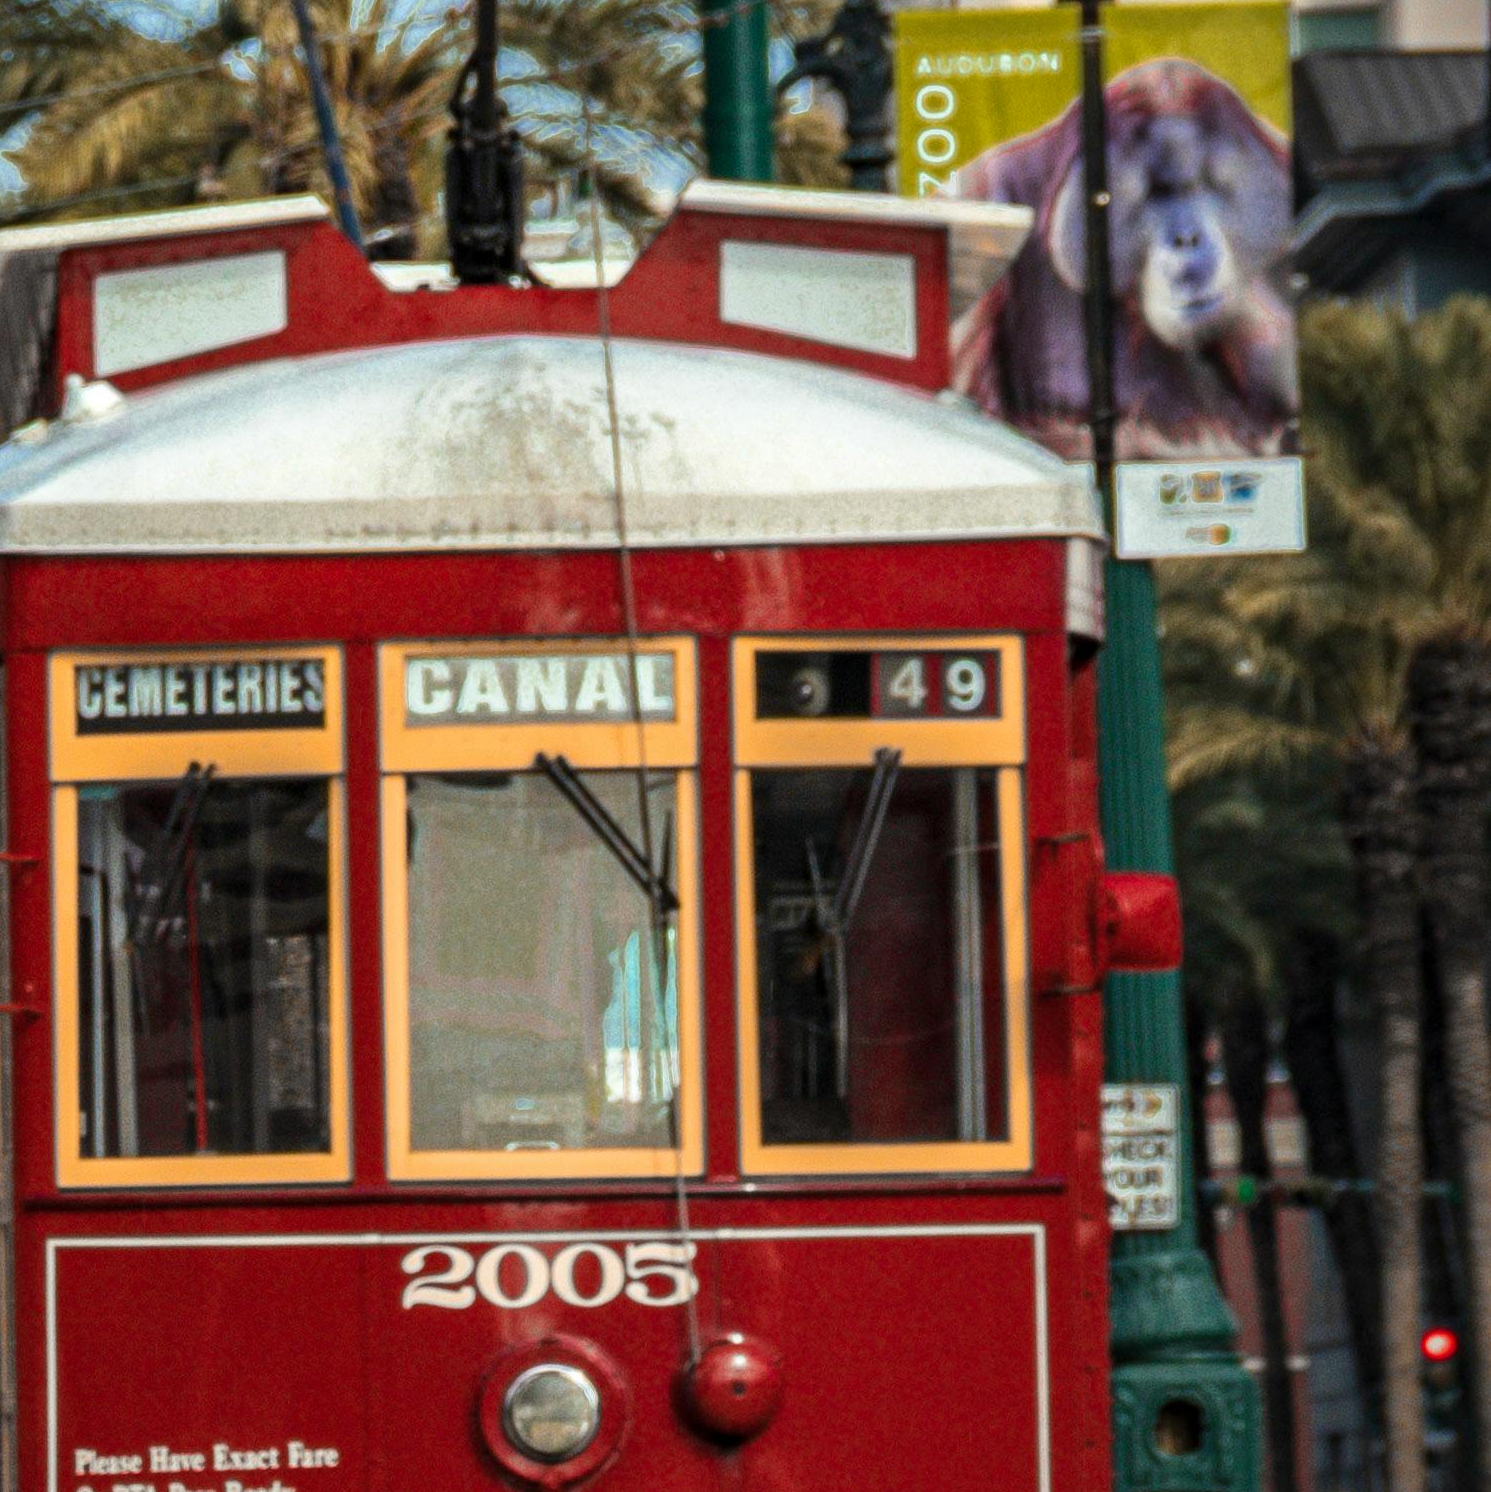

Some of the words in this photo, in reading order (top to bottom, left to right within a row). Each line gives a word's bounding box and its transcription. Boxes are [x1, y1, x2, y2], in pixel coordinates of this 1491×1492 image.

[916, 52, 1061, 76] AUDUBON
[915, 84, 957, 197] ZOO
[78, 661, 324, 719] CEMETERIES
[406, 656, 674, 715] CANAL
[400, 1241, 699, 1310] 2005
[74, 1448, 143, 1476] Please
[149, 1445, 206, 1473] Have
[213, 1442, 280, 1471] Exact
[287, 1440, 340, 1469] Fare
